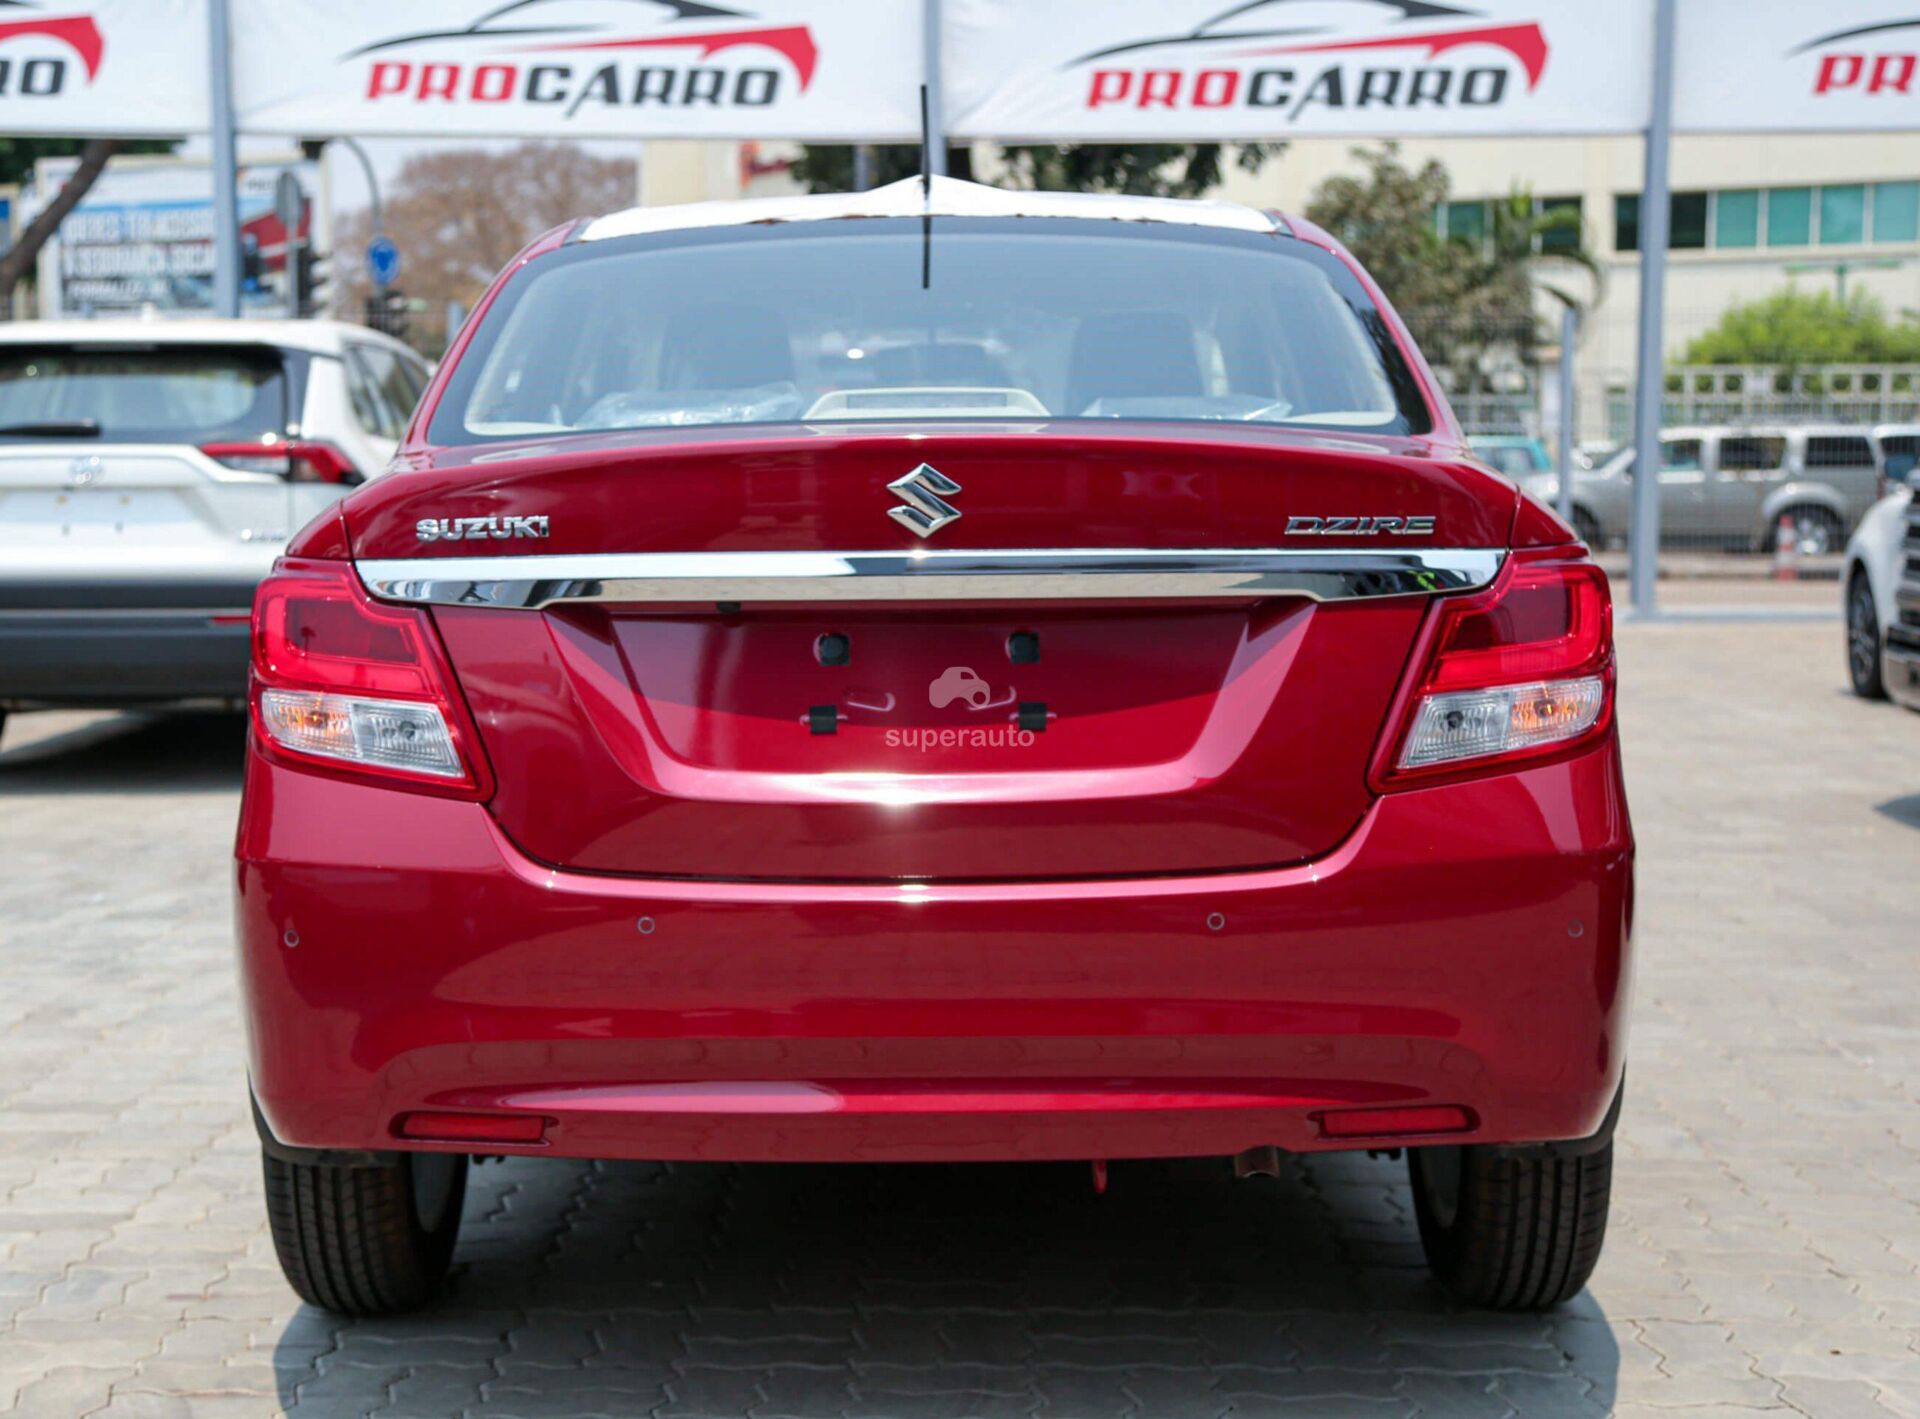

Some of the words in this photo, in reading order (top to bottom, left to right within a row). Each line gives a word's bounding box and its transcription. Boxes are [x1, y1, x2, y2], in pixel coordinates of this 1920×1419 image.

[367, 62, 781, 119] PROCARRO
[1087, 64, 1508, 122] PROCARRO
[416, 515, 549, 541] SUZUKI
[1284, 516, 1437, 535] DZIRE
